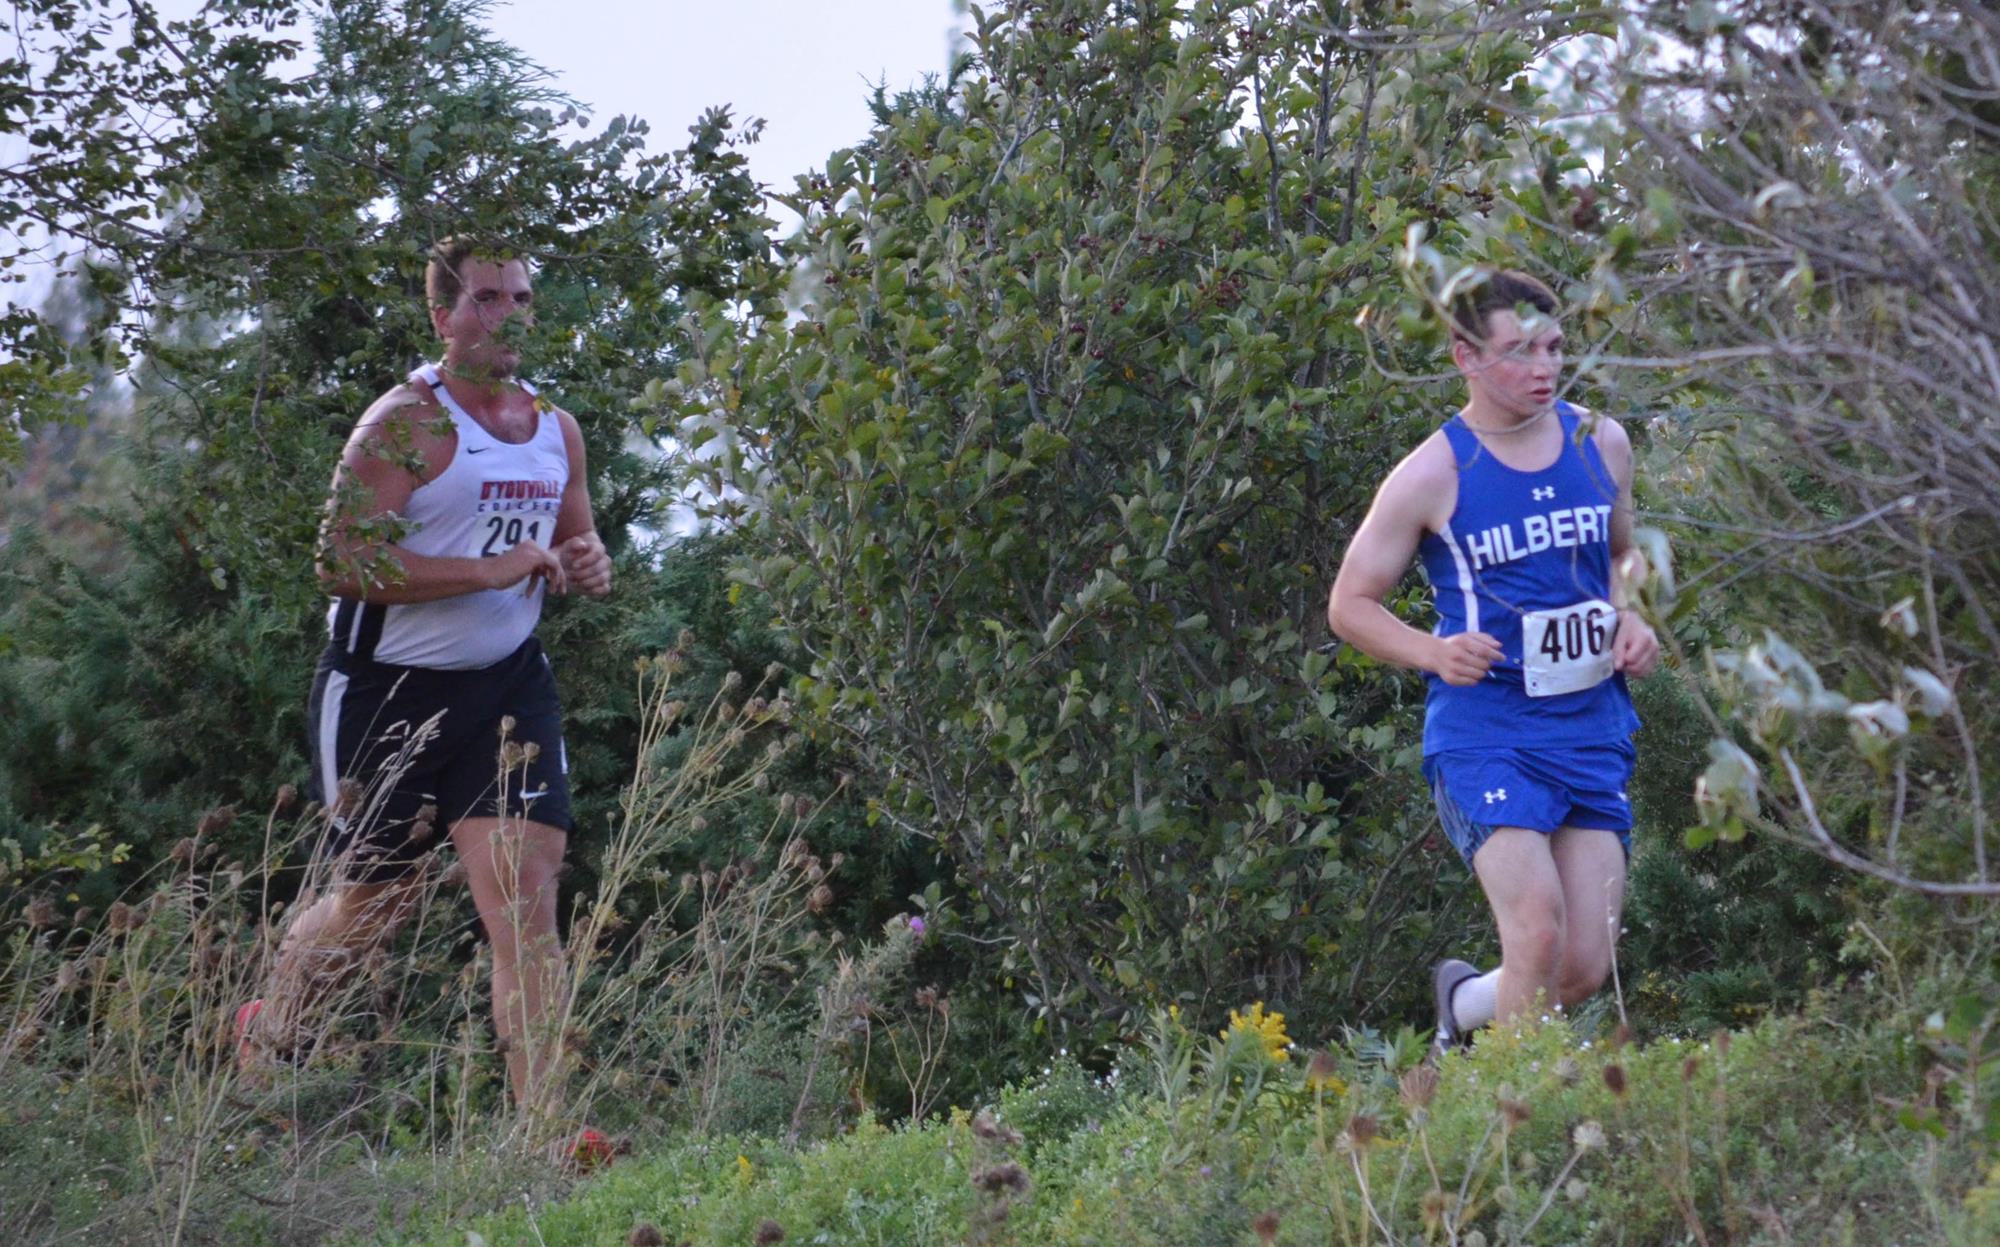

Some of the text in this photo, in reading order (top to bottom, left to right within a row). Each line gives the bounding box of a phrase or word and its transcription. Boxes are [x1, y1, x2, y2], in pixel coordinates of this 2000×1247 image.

[478, 501, 557, 512] COLLEG
[1467, 505, 1611, 569] HILBERT
[1541, 608, 1605, 663] 406
